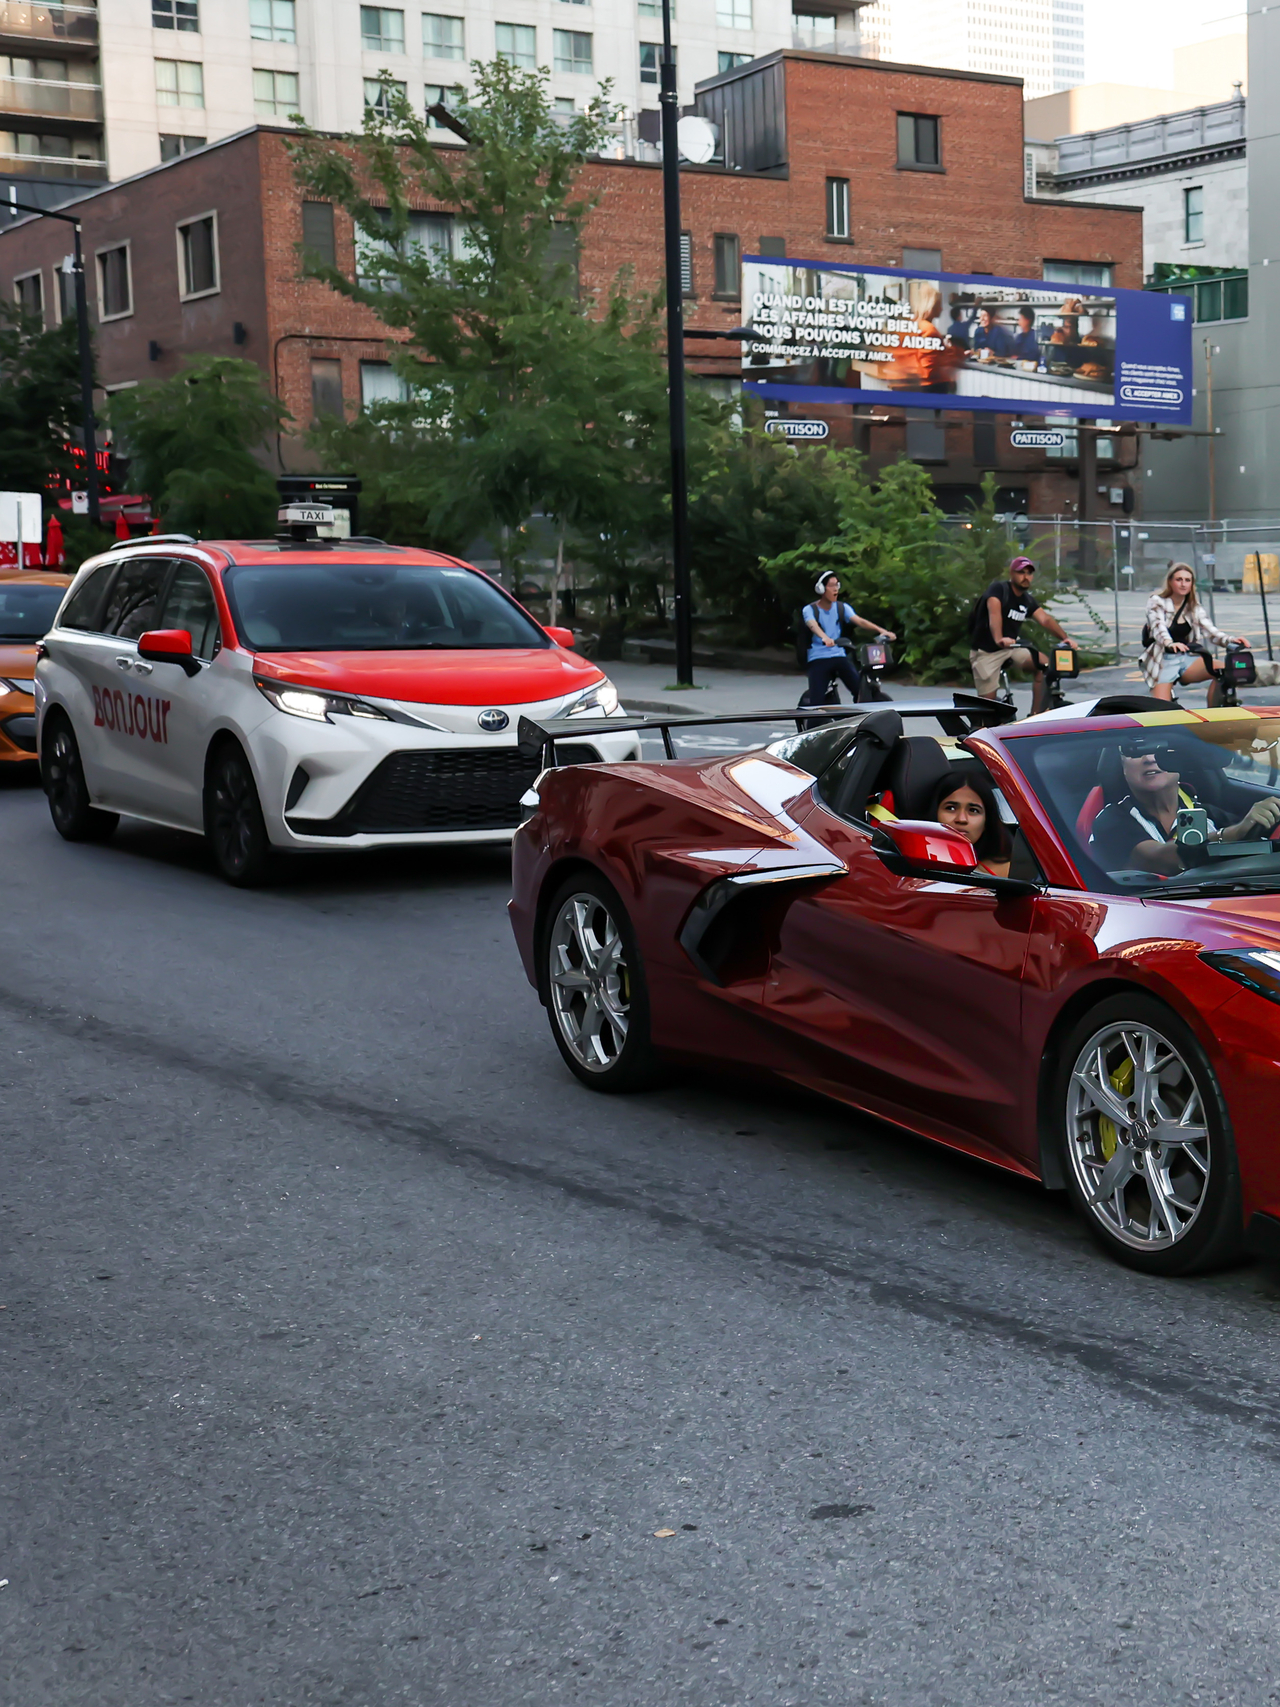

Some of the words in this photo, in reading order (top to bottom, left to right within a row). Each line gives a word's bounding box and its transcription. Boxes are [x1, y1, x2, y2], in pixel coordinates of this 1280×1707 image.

[753, 293, 802, 308] QUAND
[805, 297, 826, 310] ON
[829, 298, 855, 312] EST
[857, 301, 915, 319] OCCUPÉ,
[753, 308, 779, 322] LES
[782, 311, 845, 328] AFFAIRES
[849, 317, 884, 331] VONT
[888, 319, 922, 334] BIEN.
[753, 323, 792, 339] NOUS
[795, 327, 861, 344] POUVONS
[864, 332, 900, 348] VOUS
[902, 335, 945, 351] AIDER.
[752, 343, 811, 357] COMMENCEZ
[812, 345, 820, 357] À
[820, 348, 866, 361] ACCEPTER
[867, 351, 896, 362] AMEX.
[770, 422, 823, 435] TTISON
[1015, 433, 1061, 444] PATTISON
[300, 511, 324, 520] TAXI
